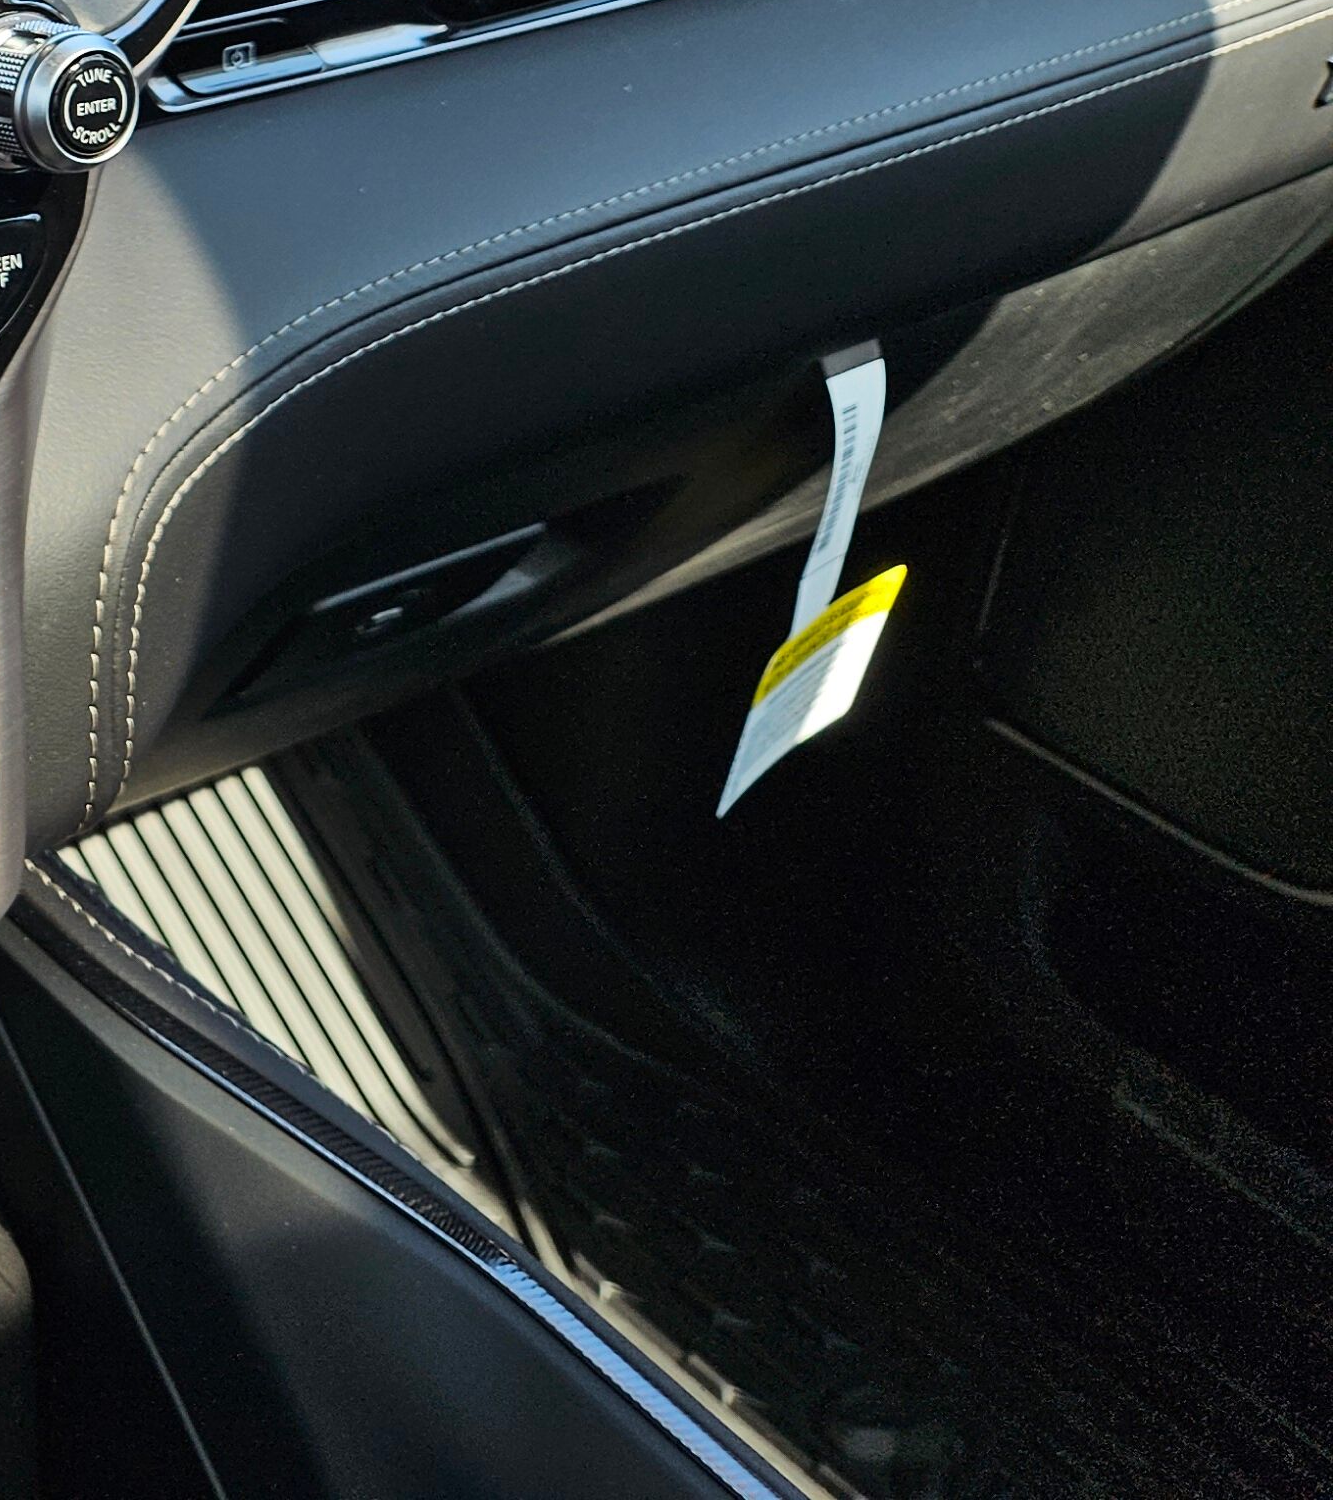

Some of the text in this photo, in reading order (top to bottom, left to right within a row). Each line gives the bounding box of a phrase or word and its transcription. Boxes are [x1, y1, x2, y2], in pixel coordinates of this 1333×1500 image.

[75, 67, 113, 88] TUNE
[76, 97, 117, 117] ENTER
[72, 120, 121, 145] SCROLL
